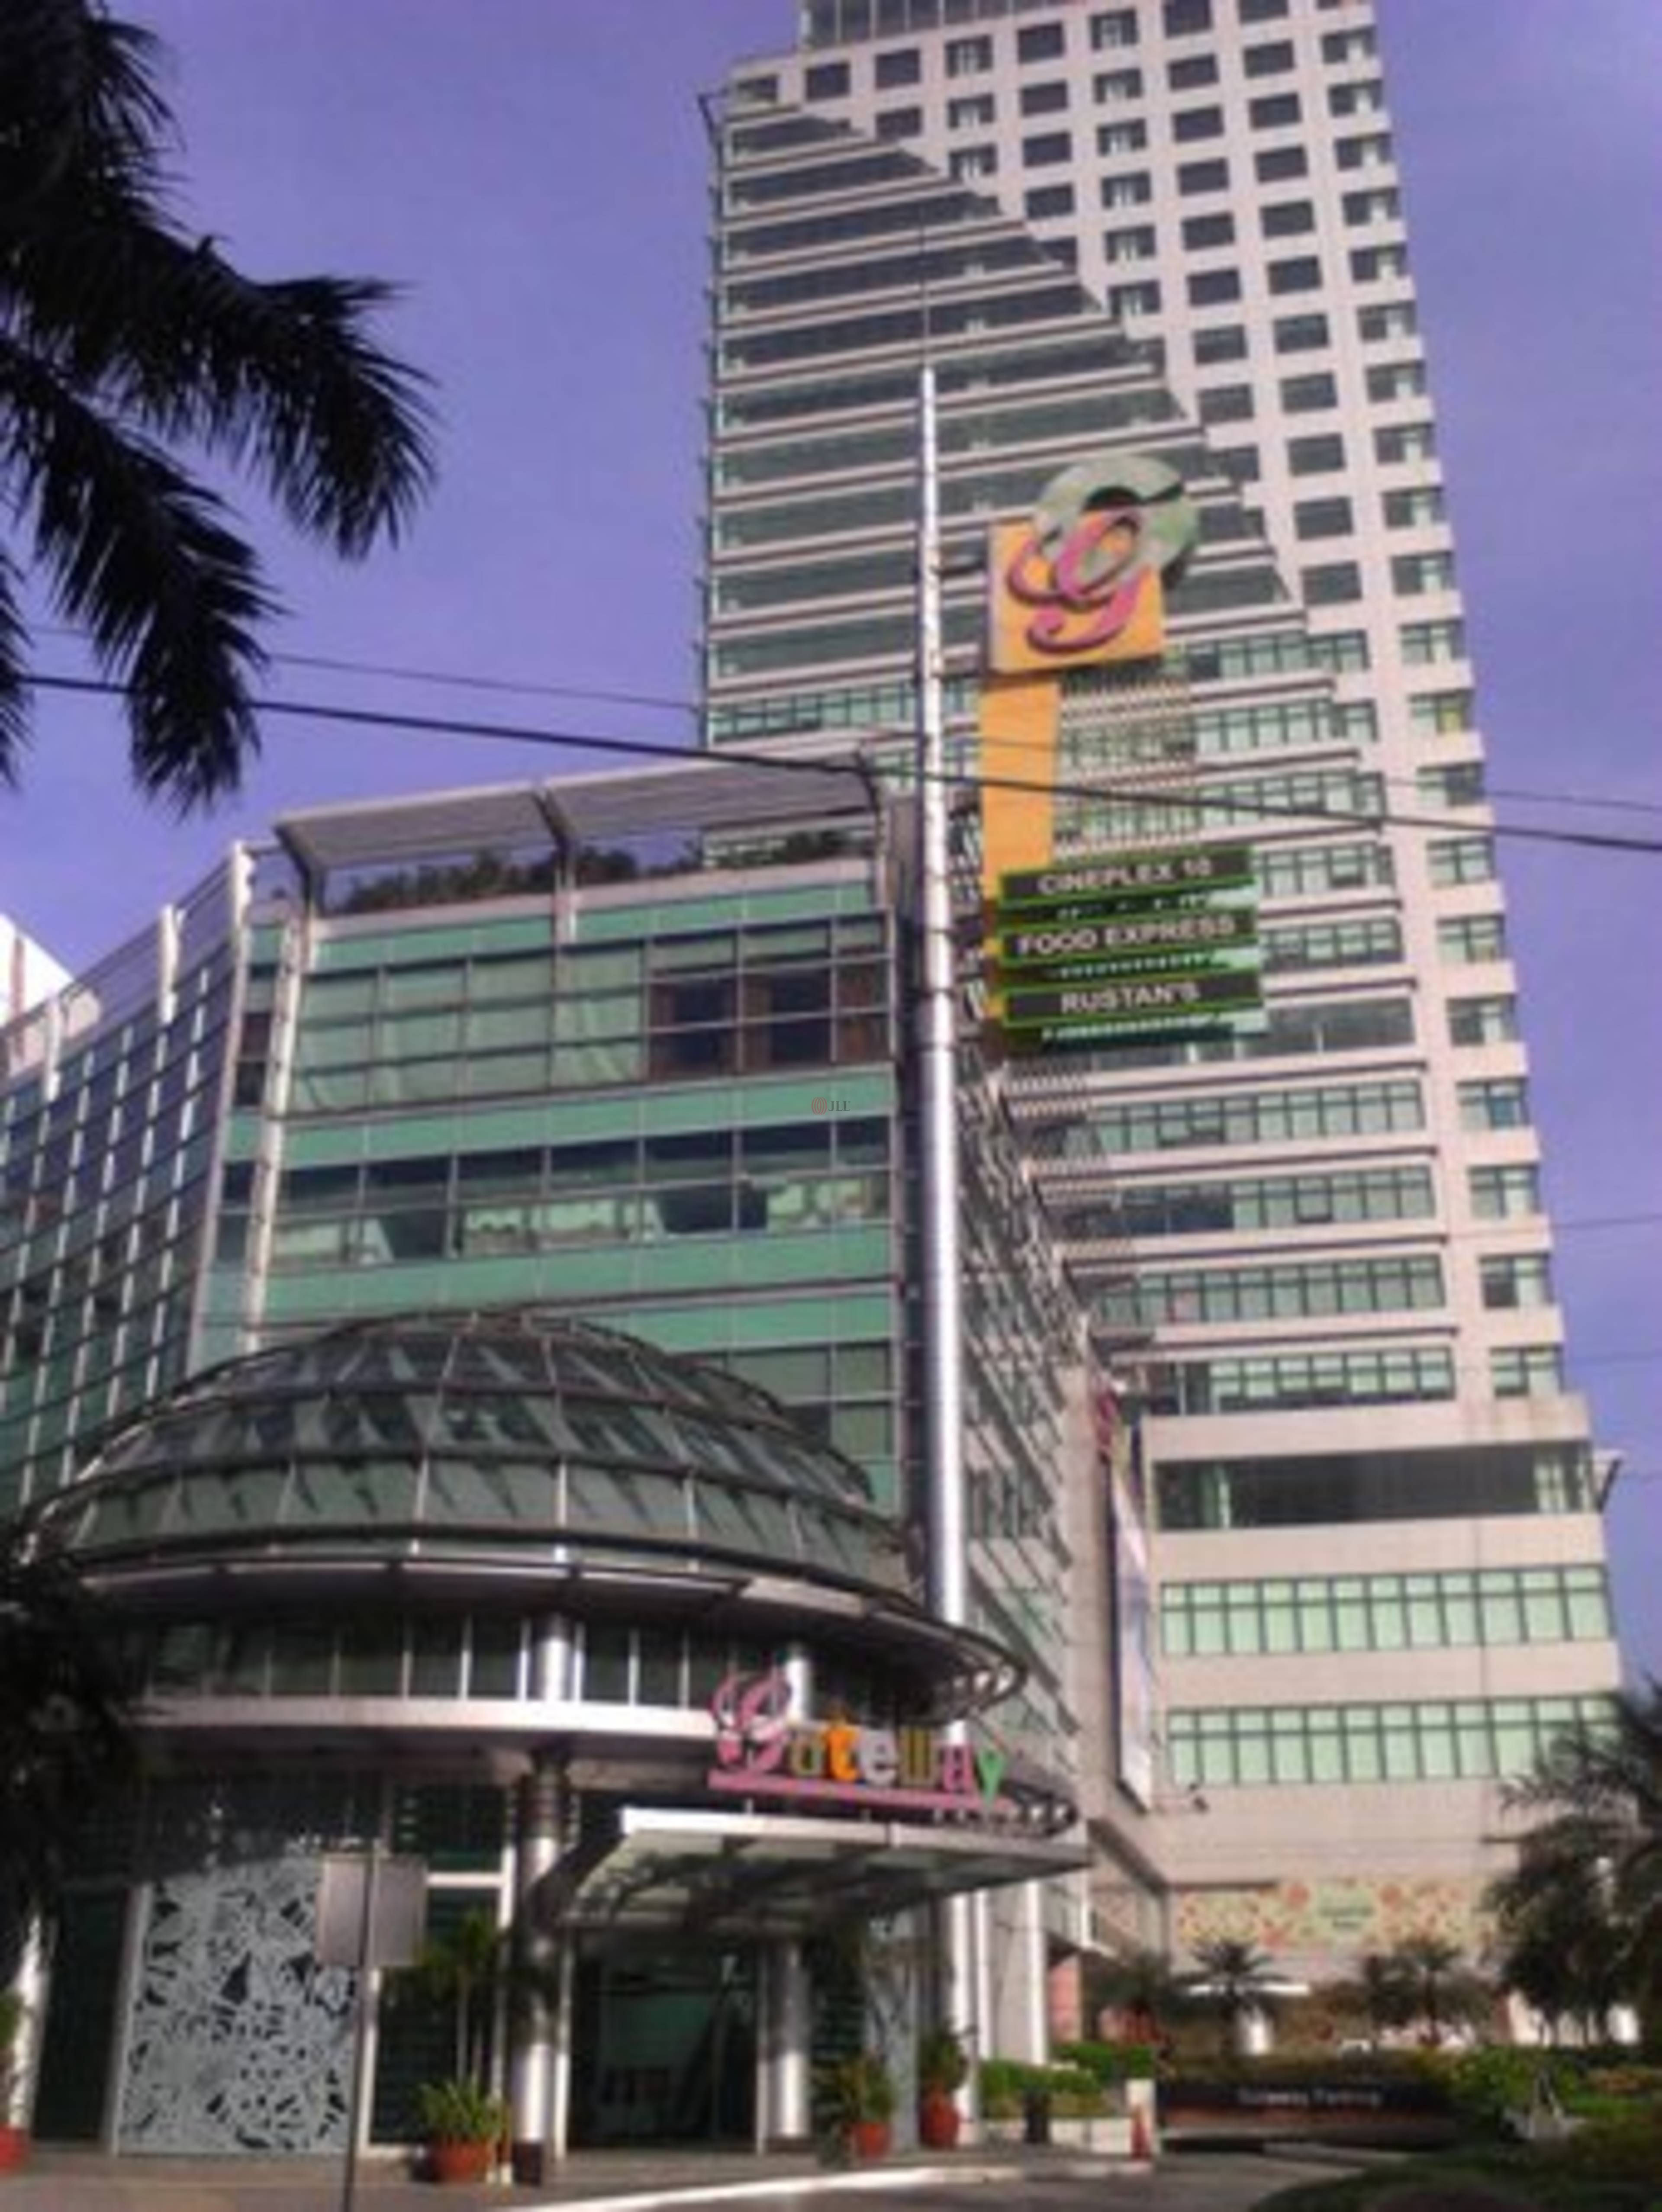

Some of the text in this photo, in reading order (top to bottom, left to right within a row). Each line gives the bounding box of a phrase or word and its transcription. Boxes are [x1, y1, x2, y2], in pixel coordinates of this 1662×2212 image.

[1037, 864, 1175, 894] CINEPLEX
[1017, 915, 1235, 955] FOOD EXPRESS
[1060, 982, 1200, 1014] RUSTAN'S
